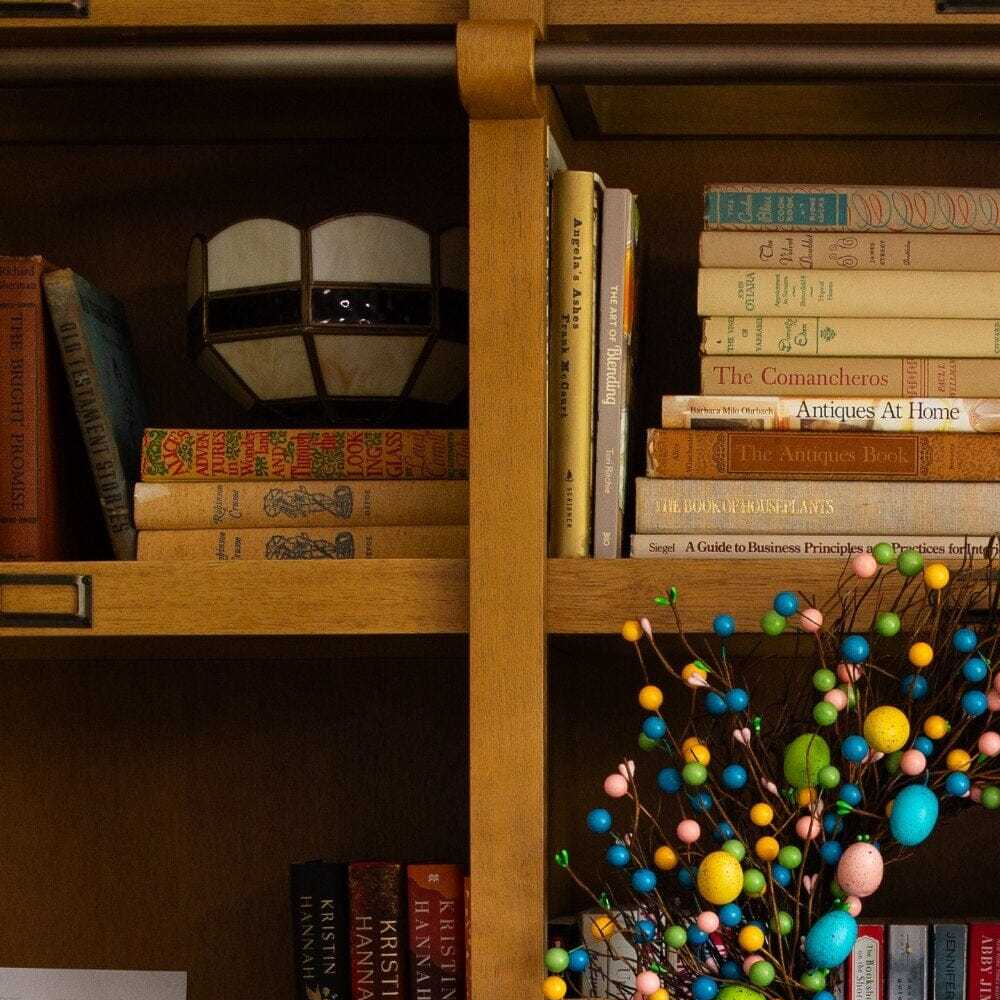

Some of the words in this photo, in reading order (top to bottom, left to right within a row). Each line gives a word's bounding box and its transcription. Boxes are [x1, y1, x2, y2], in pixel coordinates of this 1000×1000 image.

[571, 217, 584, 282] Angela's
[571, 288, 583, 330] Ashes
[609, 285, 618, 307] THE
[609, 307, 618, 328] ART
[609, 329, 618, 344] OF
[603, 345, 622, 407] Blending
[713, 366, 752, 386] The
[761, 366, 889, 387] Comancheros
[795, 401, 877, 422] Antiques
[882, 403, 905, 419] At
[909, 402, 960, 421] Home
[300, 896, 315, 979] HANNAH
[321, 899, 336, 976] KRISTIN
[414, 900, 432, 1000] HANNAH
[439, 900, 457, 1000] KRISTIN
[980, 935, 993, 974] ABBY
